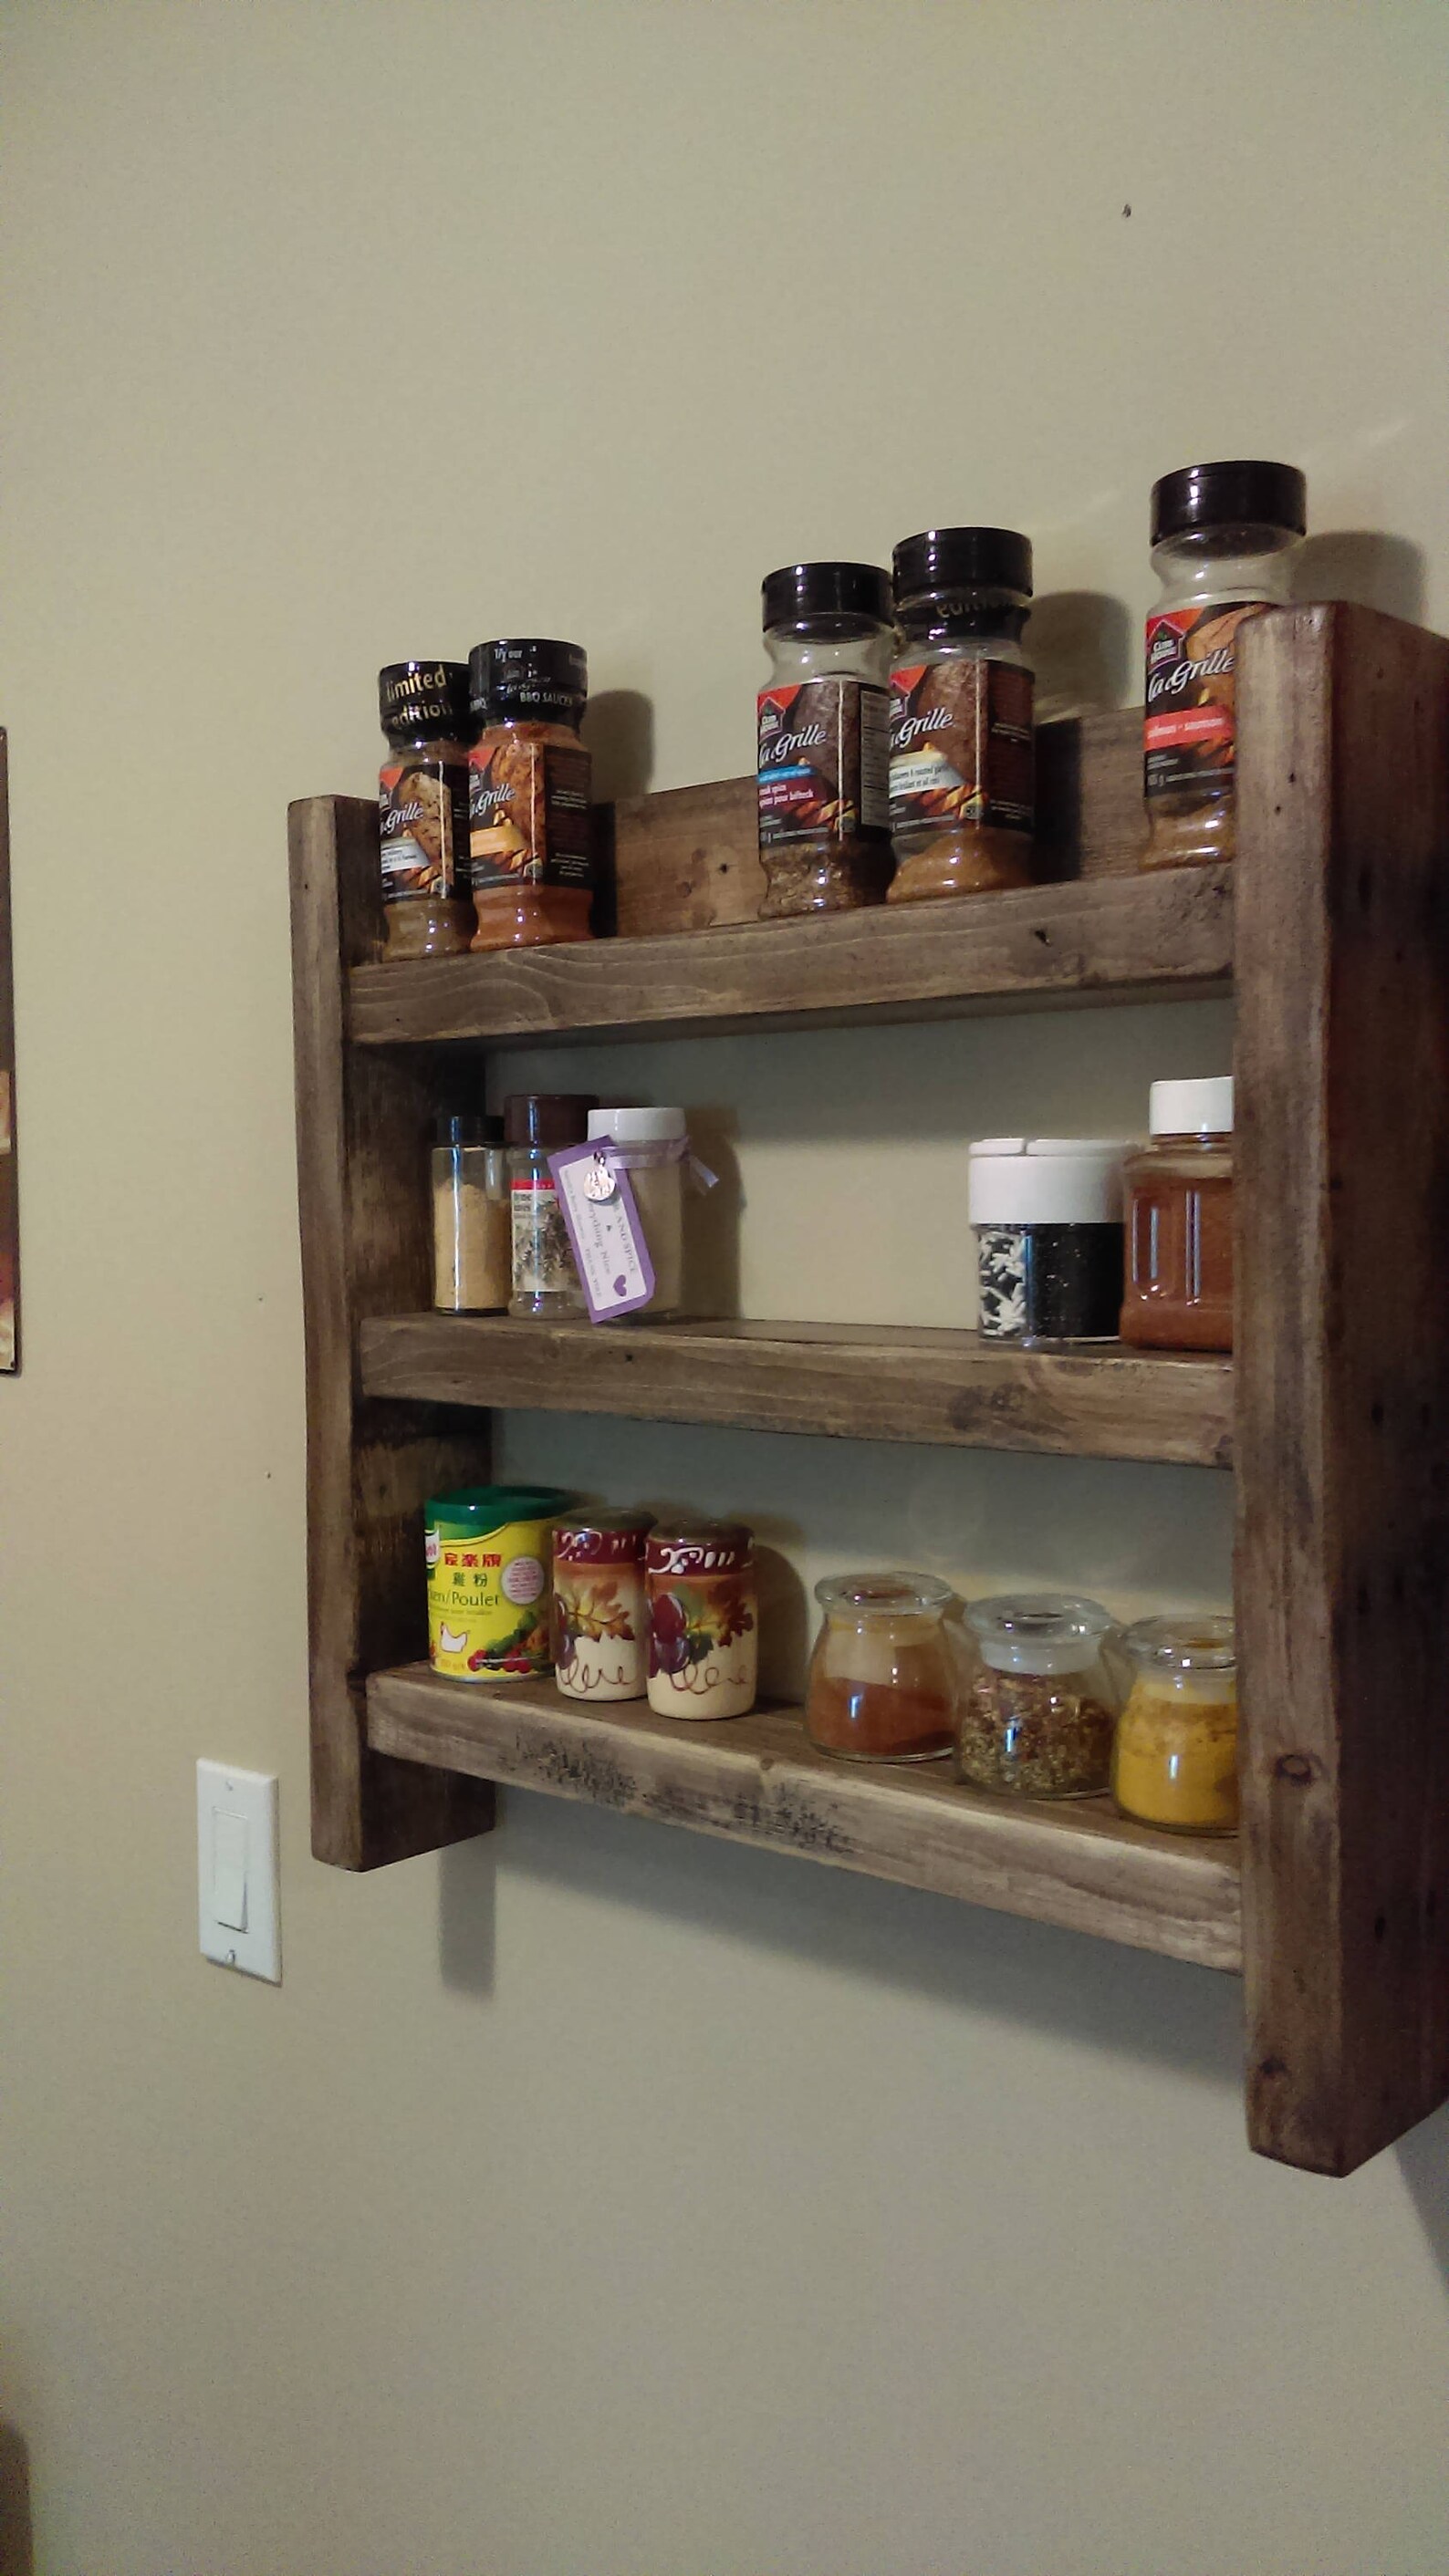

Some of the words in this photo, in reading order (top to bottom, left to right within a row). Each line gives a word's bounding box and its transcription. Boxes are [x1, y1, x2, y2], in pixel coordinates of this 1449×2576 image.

[386, 663, 447, 702] limited
[519, 691, 541, 703] BBQ
[391, 699, 453, 728] edition
[615, 1216, 628, 1241] AND
